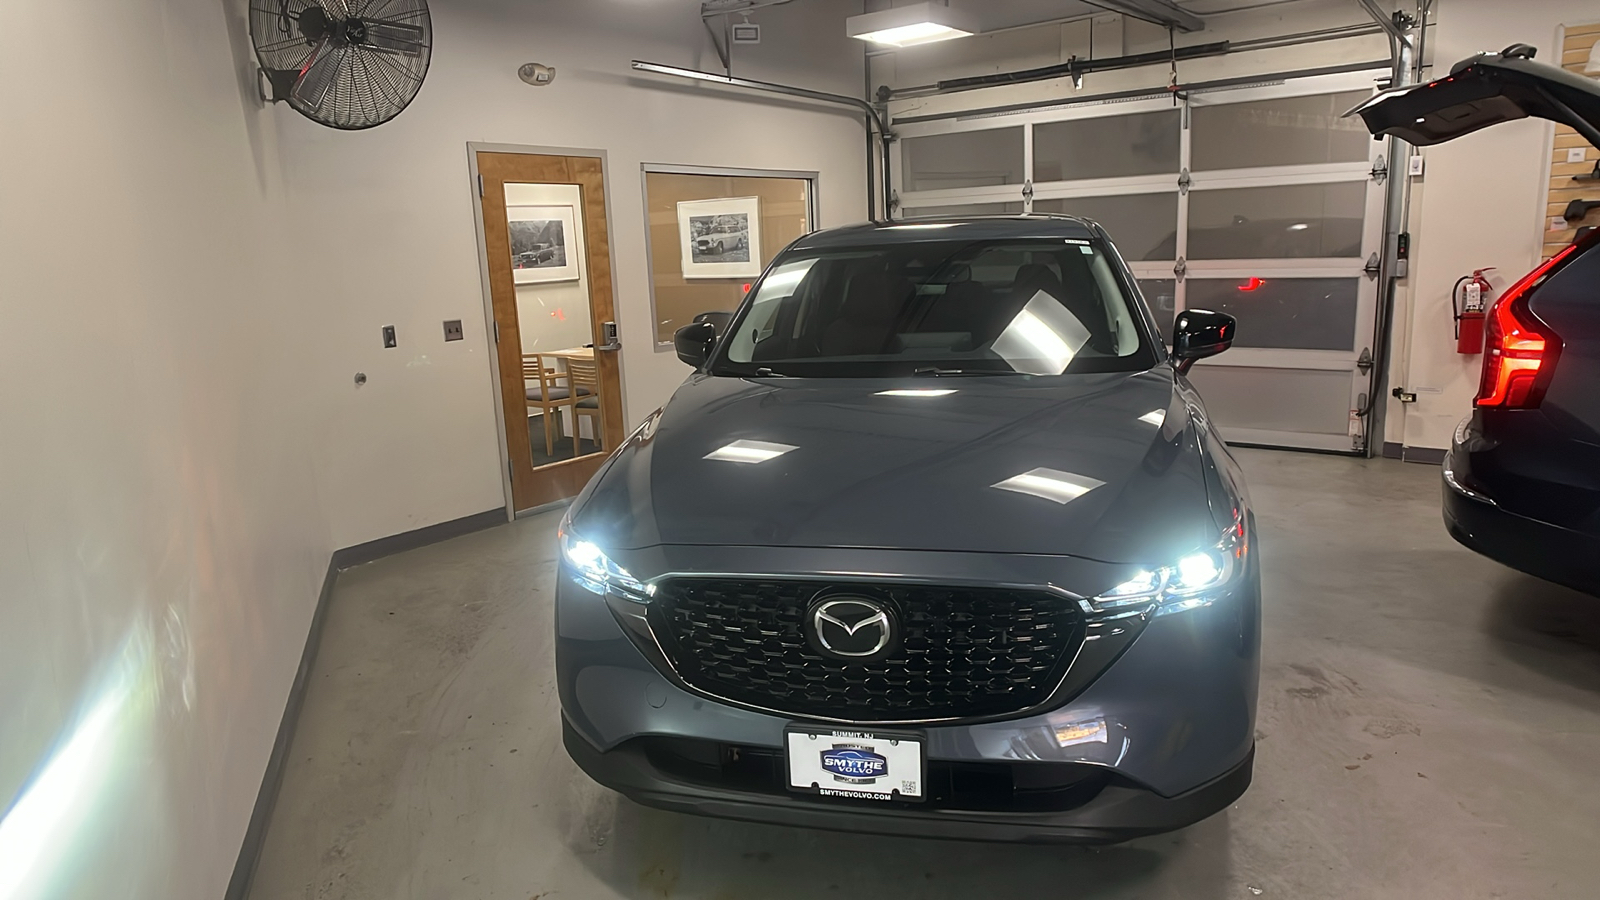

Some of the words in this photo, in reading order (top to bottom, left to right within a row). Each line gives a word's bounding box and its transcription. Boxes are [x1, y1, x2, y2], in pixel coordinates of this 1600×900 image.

[824, 758, 883, 769] SMYTHE
[838, 766, 873, 774] VOLVO
[820, 789, 891, 800] SMYTHEVOLVO.COM
